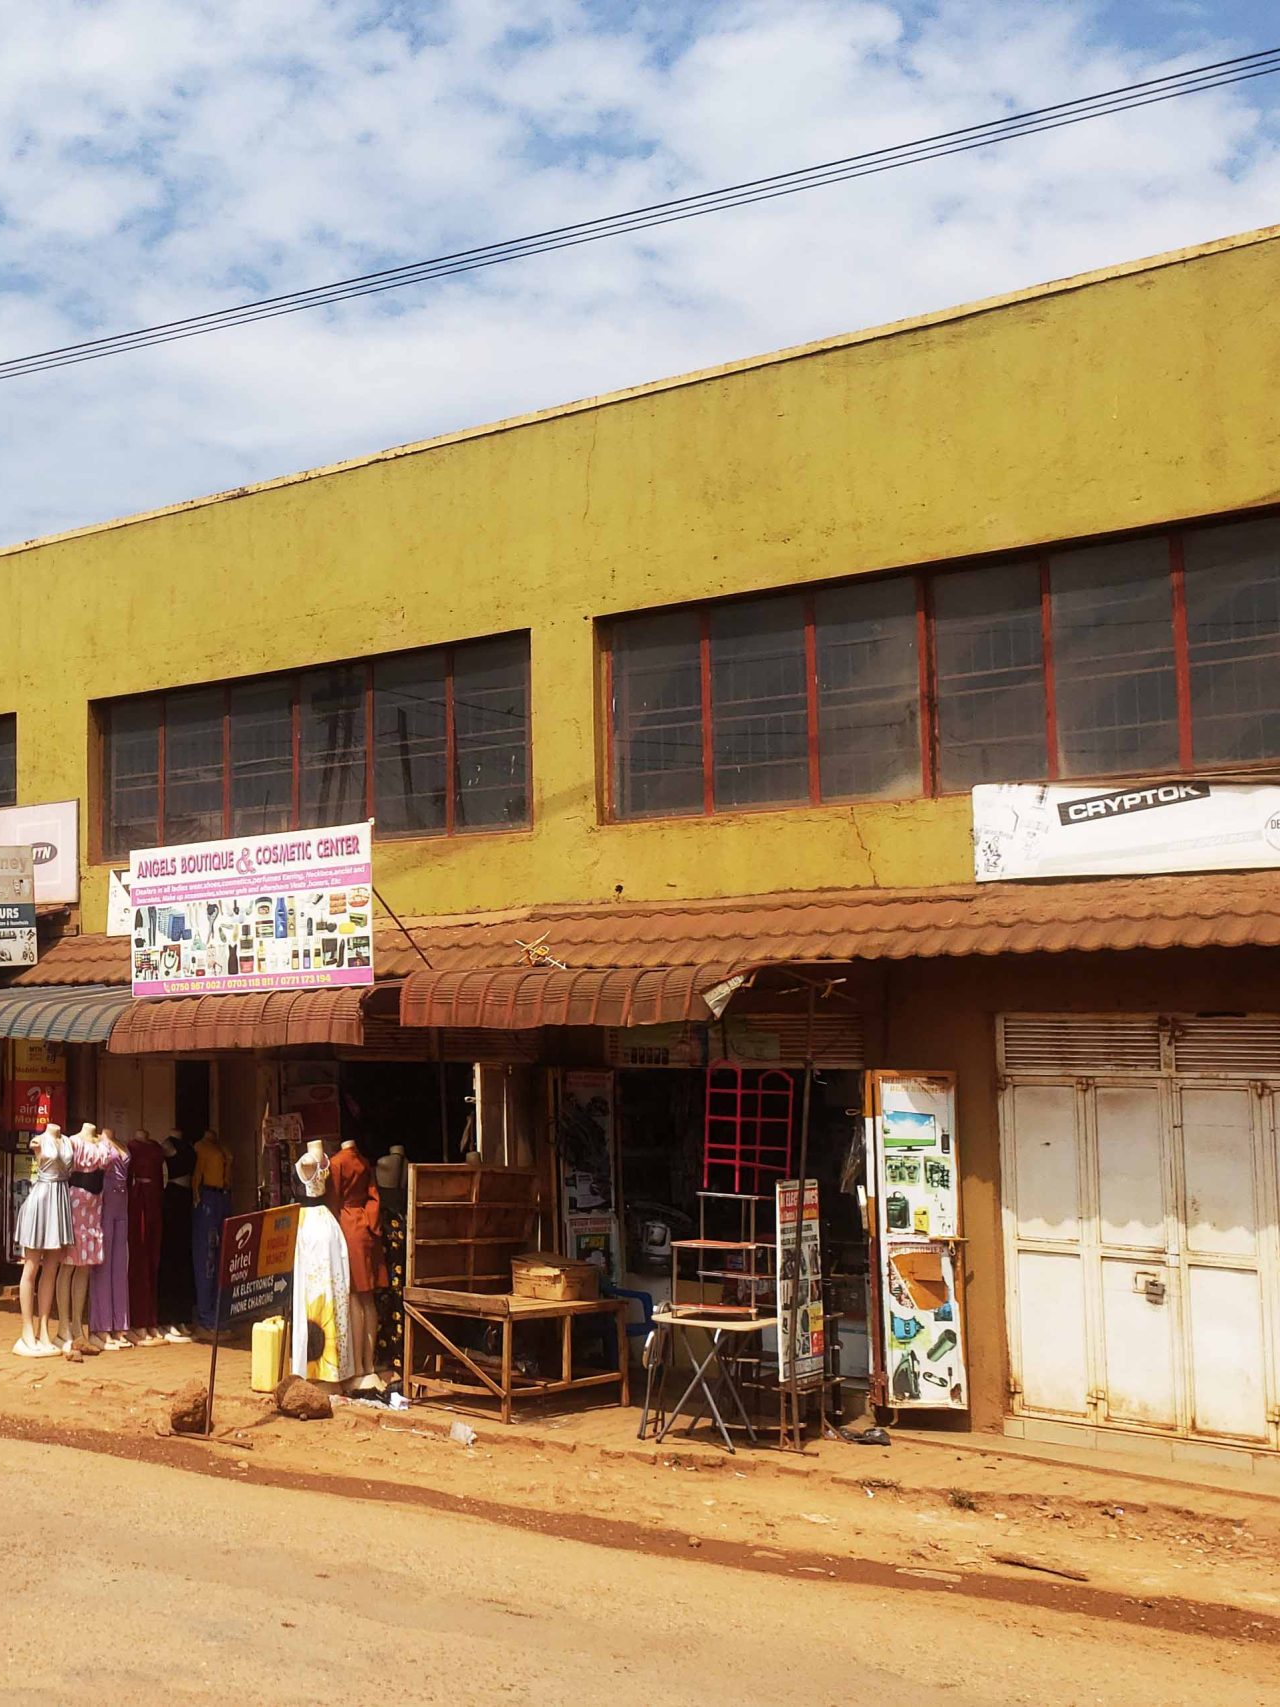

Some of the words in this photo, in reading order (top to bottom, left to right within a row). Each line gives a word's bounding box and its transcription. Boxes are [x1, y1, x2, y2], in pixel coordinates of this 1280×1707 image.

[1069, 784, 1202, 821] CRYPTOK
[137, 856, 177, 879] ANGELS
[180, 851, 234, 875] BOUTIQUE
[235, 847, 257, 875] &
[255, 841, 312, 867] COSMETIC
[316, 834, 360, 858] CENTER
[19, 1104, 49, 1115] airtel
[228, 1250, 252, 1273] airtel
[230, 1268, 249, 1283] money
[232, 1283, 240, 1299] AK
[240, 1275, 275, 1297] ELECTRONICS
[230, 1299, 248, 1316] PHONE
[247, 1290, 275, 1312] CHARGING
